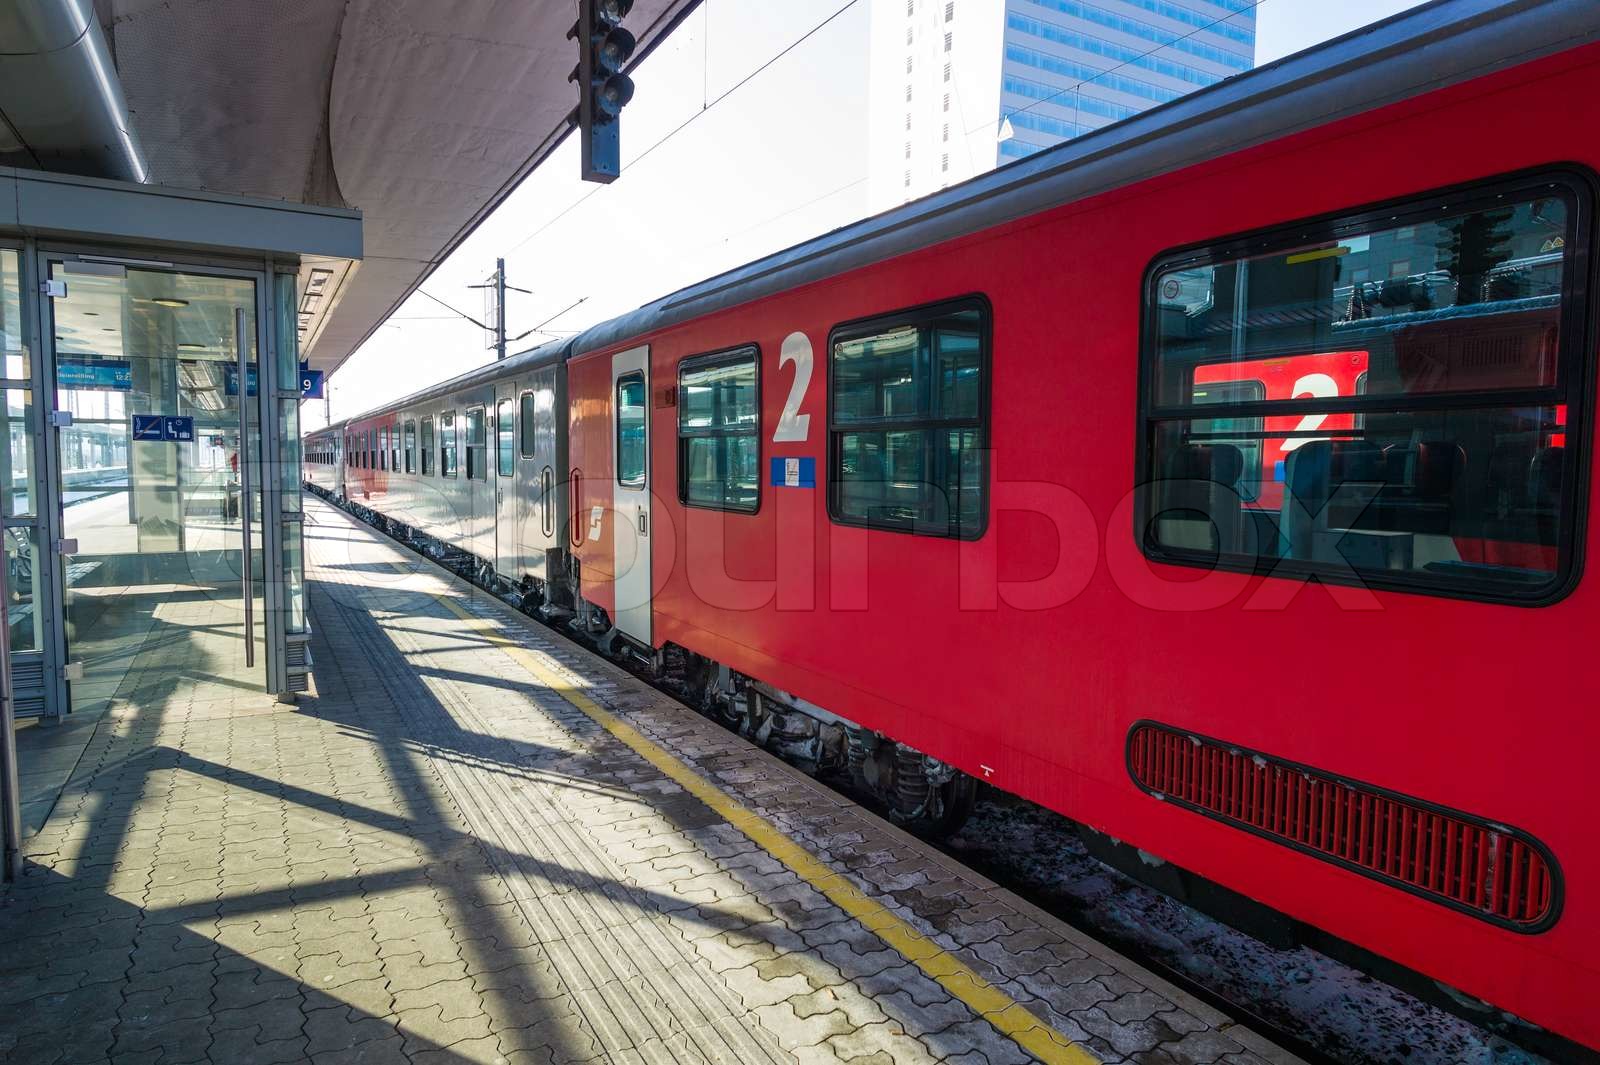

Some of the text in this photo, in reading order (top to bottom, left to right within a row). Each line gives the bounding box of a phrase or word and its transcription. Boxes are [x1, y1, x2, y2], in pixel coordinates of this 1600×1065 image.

[303, 379, 312, 391] 9
[773, 331, 814, 443] 2
[1279, 373, 1339, 451] 2
